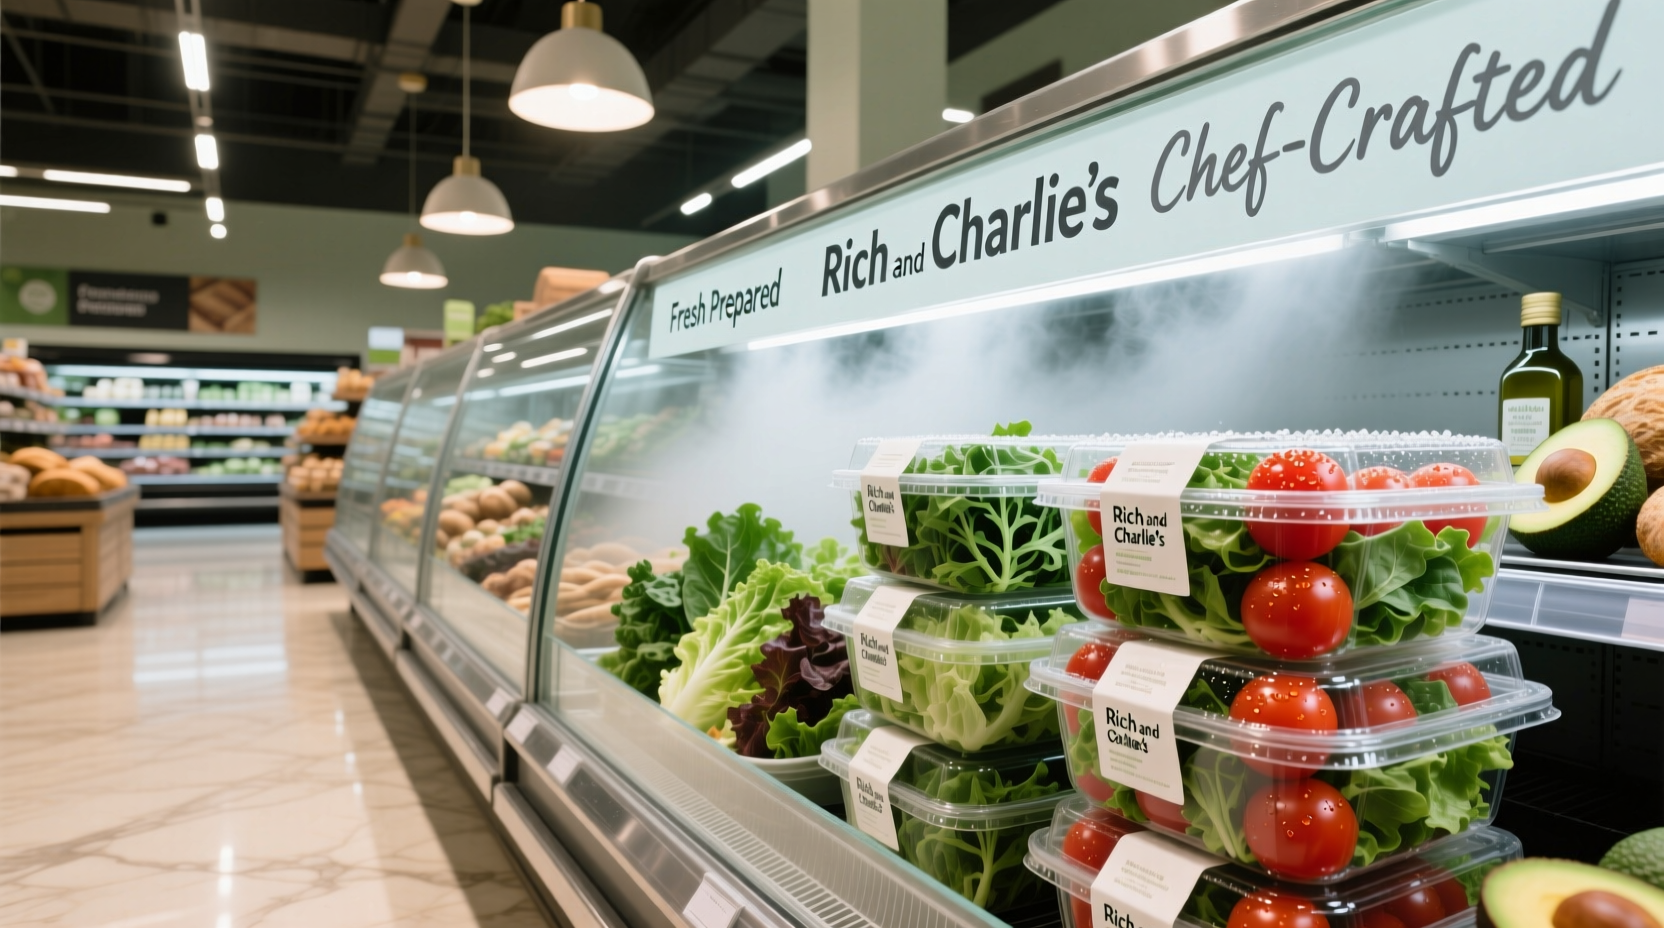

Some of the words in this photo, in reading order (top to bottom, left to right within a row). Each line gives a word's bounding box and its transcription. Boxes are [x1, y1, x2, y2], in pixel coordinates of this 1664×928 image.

[1150, 0, 1623, 217] Chef-Crafted
[821, 229, 888, 297] Rich
[892, 242, 925, 279] and
[932, 161, 1119, 270] Charlie's
[670, 292, 706, 333] Fresh
[709, 267, 783, 328] Prepared
[1113, 505, 1144, 526] Rich
[1146, 512, 1167, 528] and
[1114, 527, 1165, 547] Charlie's
[1106, 706, 1137, 733] Rich
[1138, 723, 1160, 739] and
[1103, 902, 1135, 928] Rich
